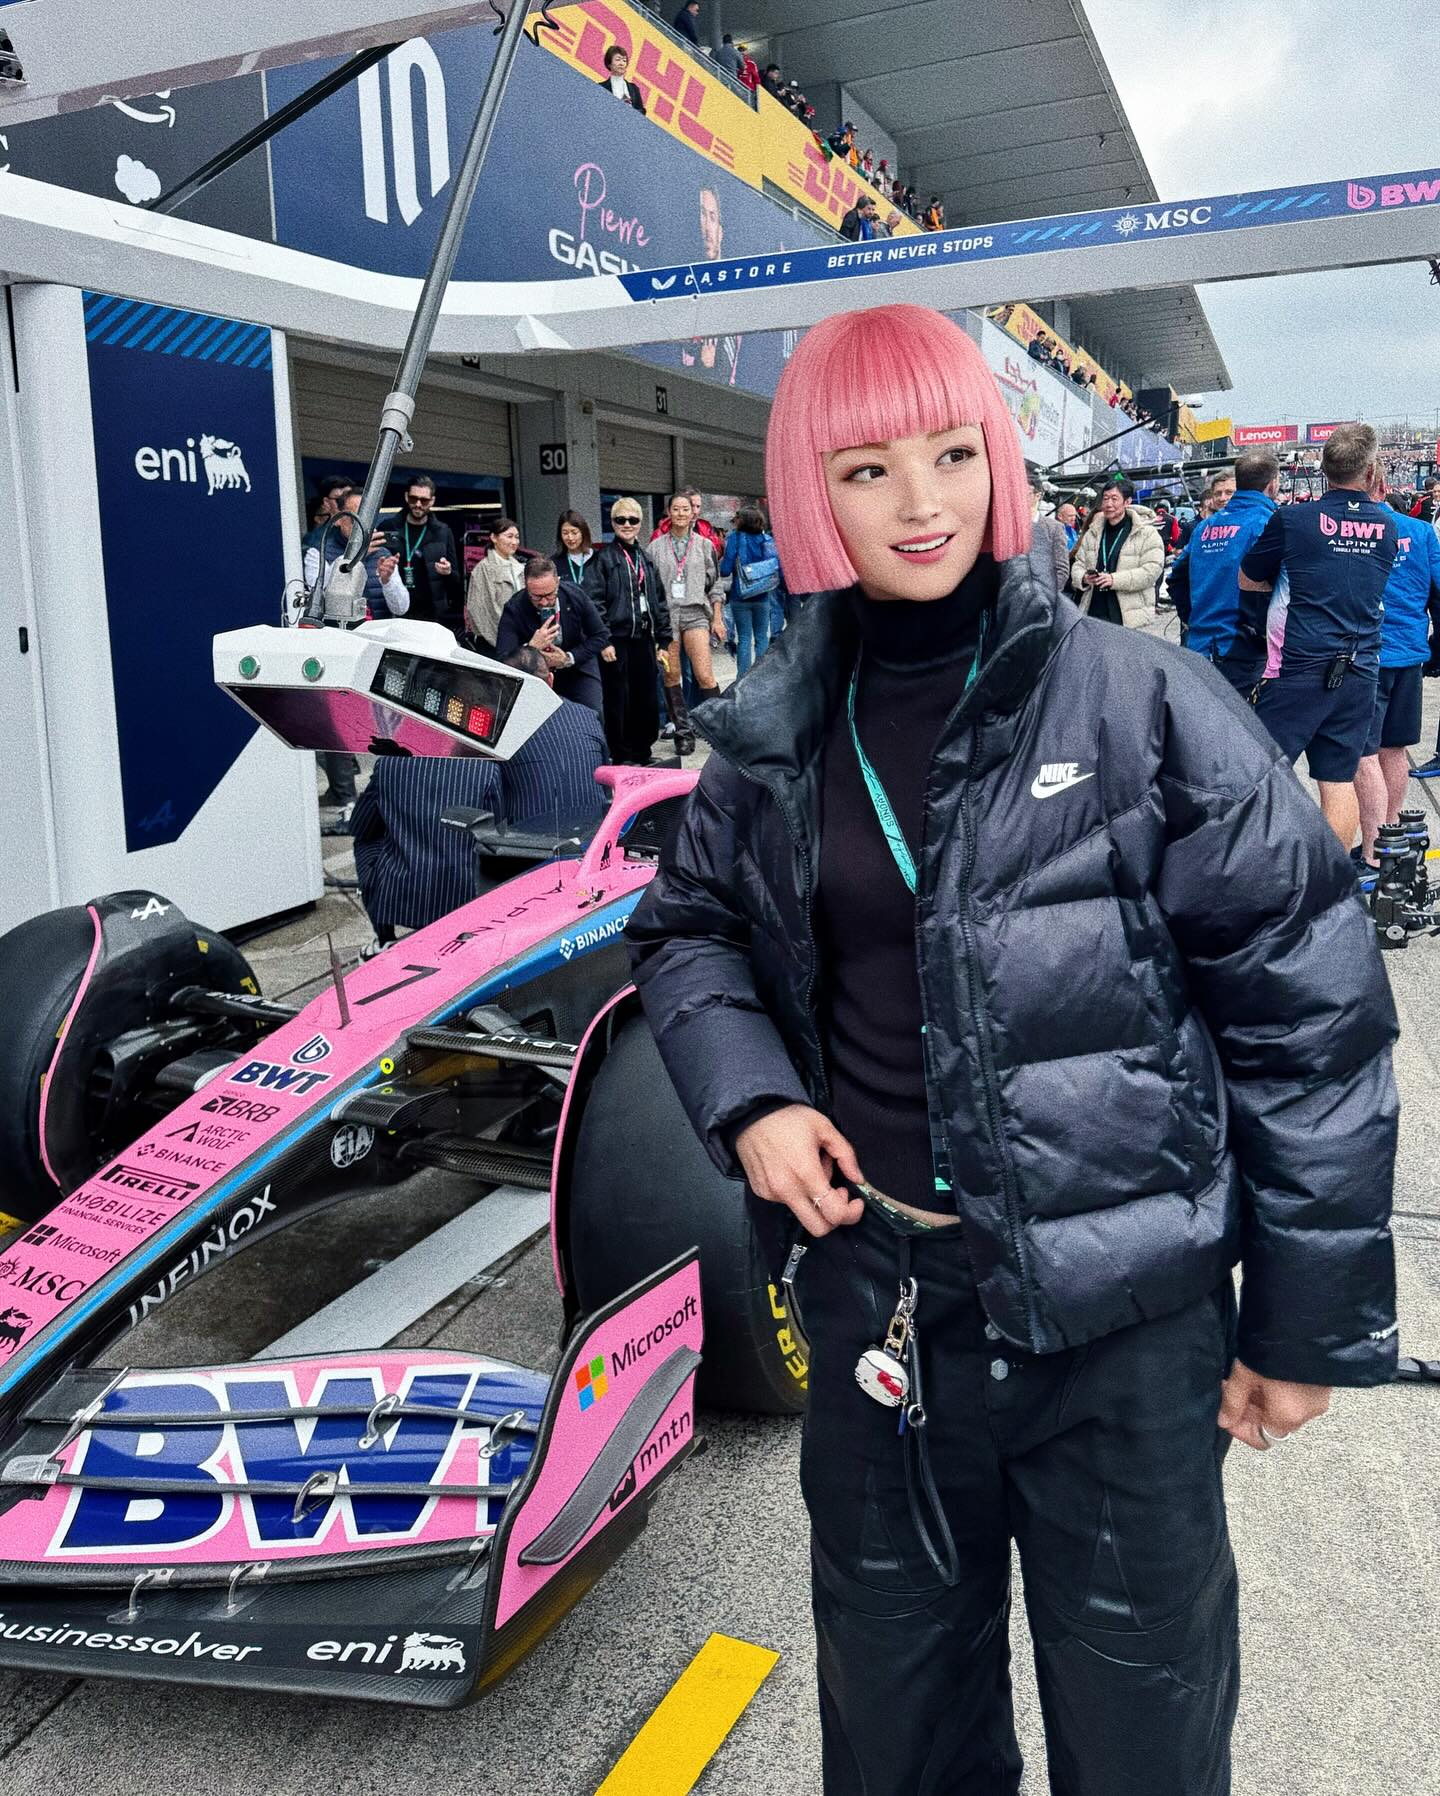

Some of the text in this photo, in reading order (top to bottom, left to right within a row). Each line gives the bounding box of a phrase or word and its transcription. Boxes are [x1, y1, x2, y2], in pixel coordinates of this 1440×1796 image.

[802, 141, 868, 220] DH
[1144, 206, 1211, 230] MSC
[828, 236, 993, 268] BETTER NEVER STOPS
[685, 262, 791, 285] CASTORE
[657, 391, 667, 411] 31
[1240, 431, 1281, 441] Lenovo
[1314, 429, 1333, 437] Len
[135, 438, 197, 482] eni
[542, 449, 566, 470] 30
[1210, 525, 1240, 540] BWT
[1341, 520, 1385, 539] BWT
[1201, 541, 1229, 549] ALPINE
[1328, 539, 1377, 548] ALPINE
[1039, 763, 1078, 783] NIKE
[875, 792, 895, 828] SUNDAY
[575, 915, 630, 951] BINANCE
[352, 964, 441, 1006] 7
[465, 1032, 579, 1052] LPINE
[228, 1061, 332, 1096] BWT
[223, 1100, 280, 1123] BRB
[196, 1135, 235, 1151] WOLF
[201, 1125, 250, 1142] ARCTIC
[334, 1126, 371, 1163] FIA
[154, 1149, 226, 1173] BINANCE
[100, 1164, 200, 1201] PIRELLI
[58, 1206, 147, 1235] FINANCIAL SERVICES
[49, 1233, 122, 1263] Microsoft
[129, 1184, 277, 1328] INFINOX
[9, 1266, 87, 1301] MSC
[611, 1296, 697, 1377] Microsoft
[640, 1411, 691, 1472] mntn
[306, 1635, 398, 1664] eni
